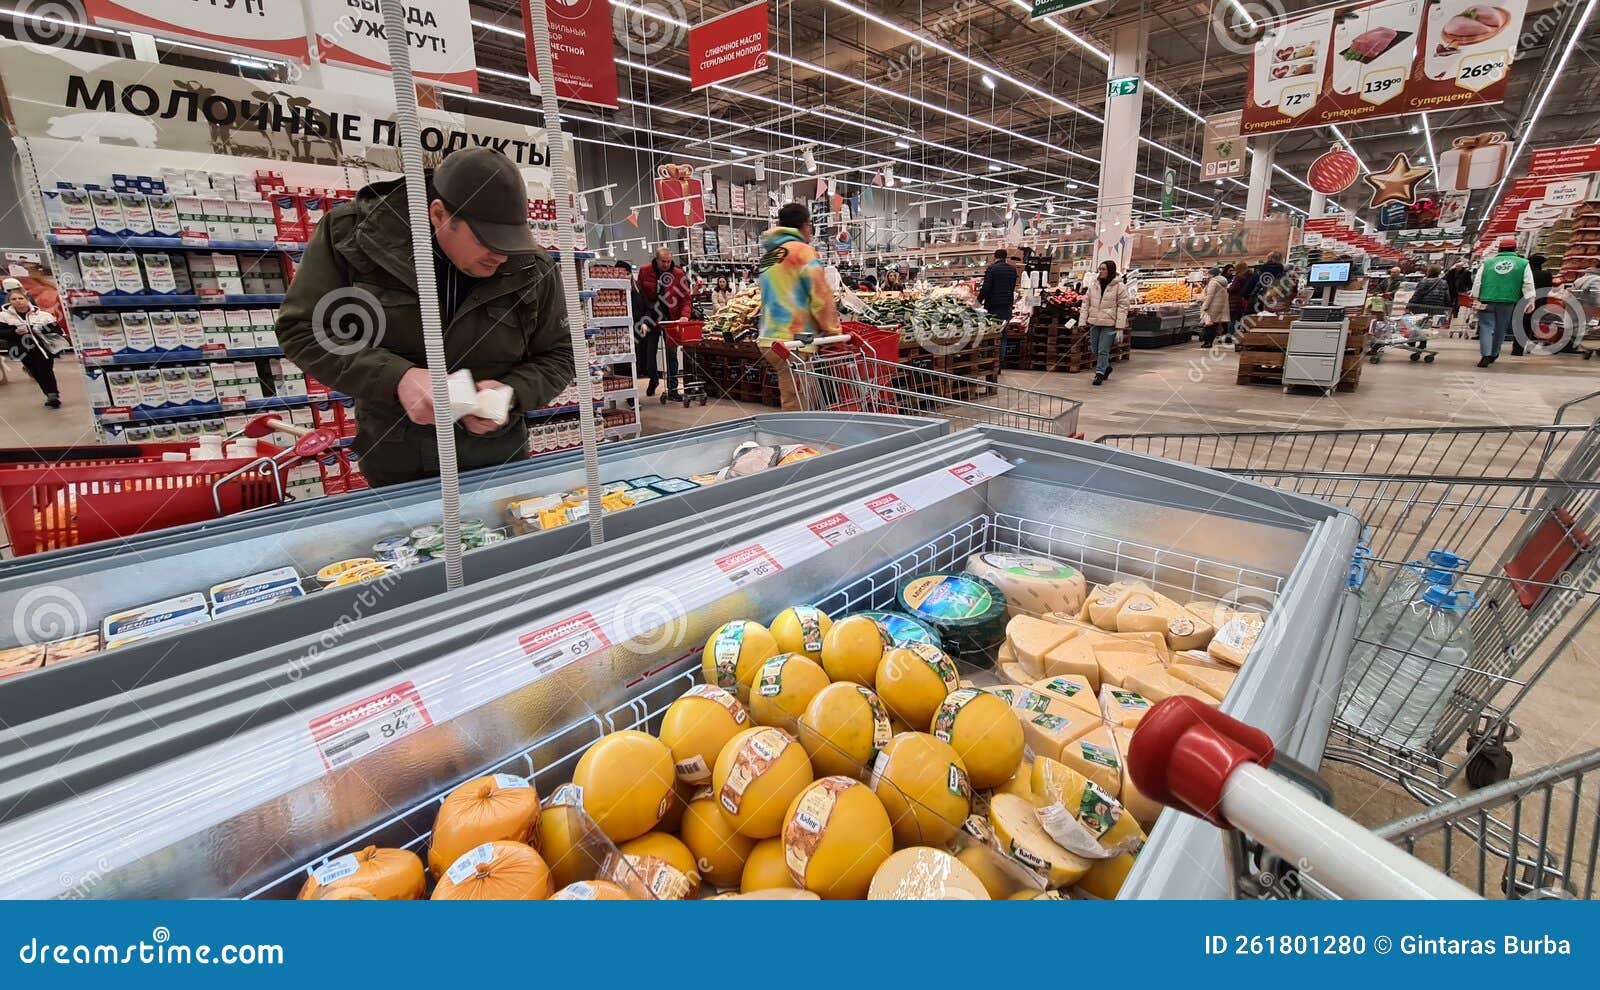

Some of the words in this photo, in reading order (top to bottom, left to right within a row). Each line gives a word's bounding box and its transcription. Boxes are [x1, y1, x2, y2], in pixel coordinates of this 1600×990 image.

[704, 39, 740, 58] СЛИВОЧНОЕ
[740, 32, 762, 47] МАСЛО
[700, 51, 736, 71] СТЕРИЛЬНОЕ
[736, 43, 762, 59] МОЛОКО
[1410, 91, 1473, 107] Суперцена
[65, 75, 361, 142] МОЛОЧНЫЕ
[372, 118, 551, 167] ПОДУКТЫ
[1321, 104, 1375, 120] Суперцена
[1244, 117, 1292, 131] Суперцена
